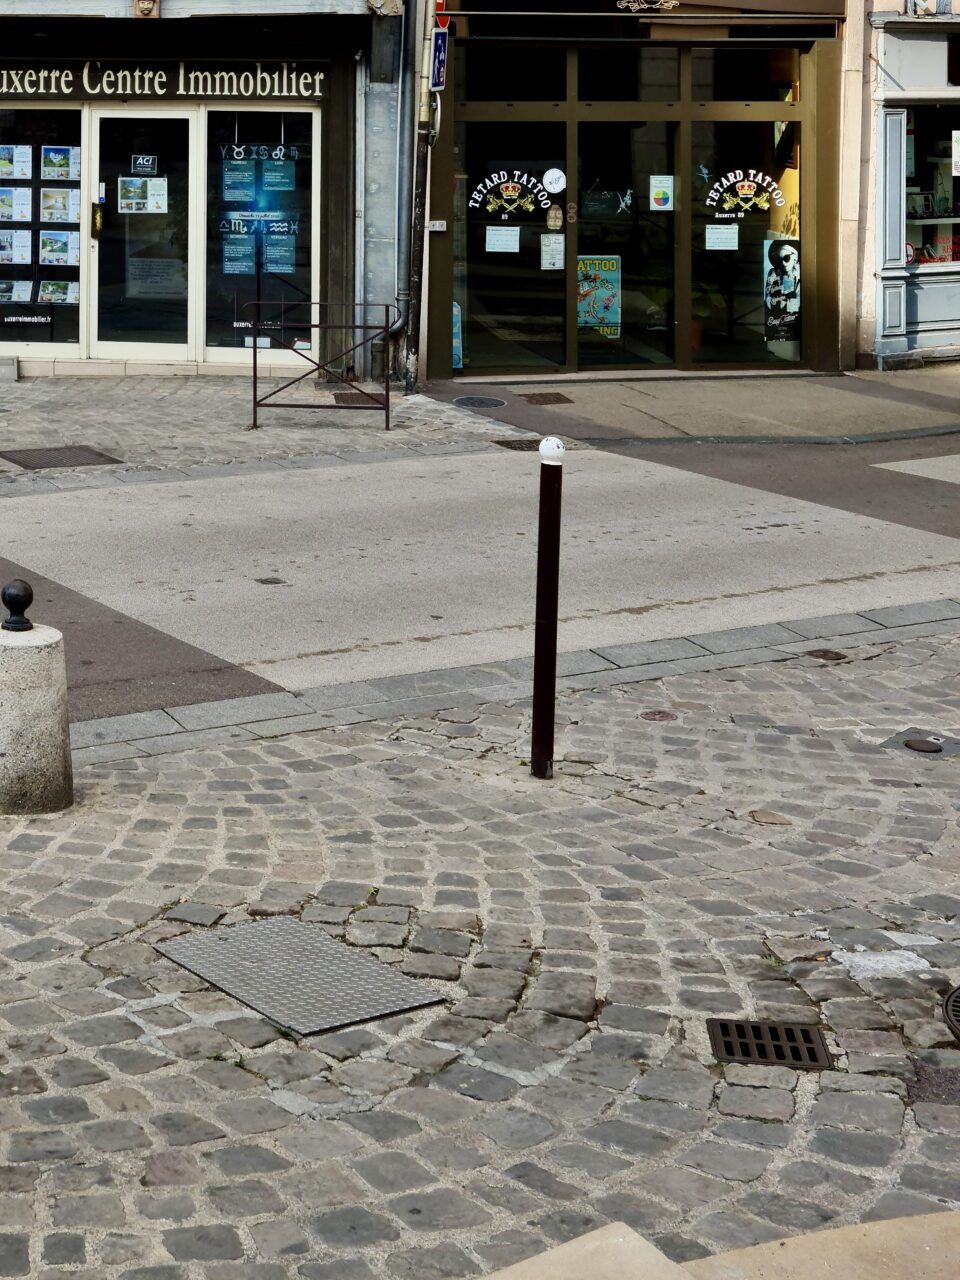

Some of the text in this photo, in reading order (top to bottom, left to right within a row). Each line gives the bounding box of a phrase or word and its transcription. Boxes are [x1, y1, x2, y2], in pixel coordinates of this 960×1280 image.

[83, 61, 167, 95] Centre
[176, 61, 325, 97] Immobilier
[136, 157, 153, 165] ACI
[468, 170, 551, 209] TETARD TATTOO
[705, 169, 786, 207] TETARD TATTOO
